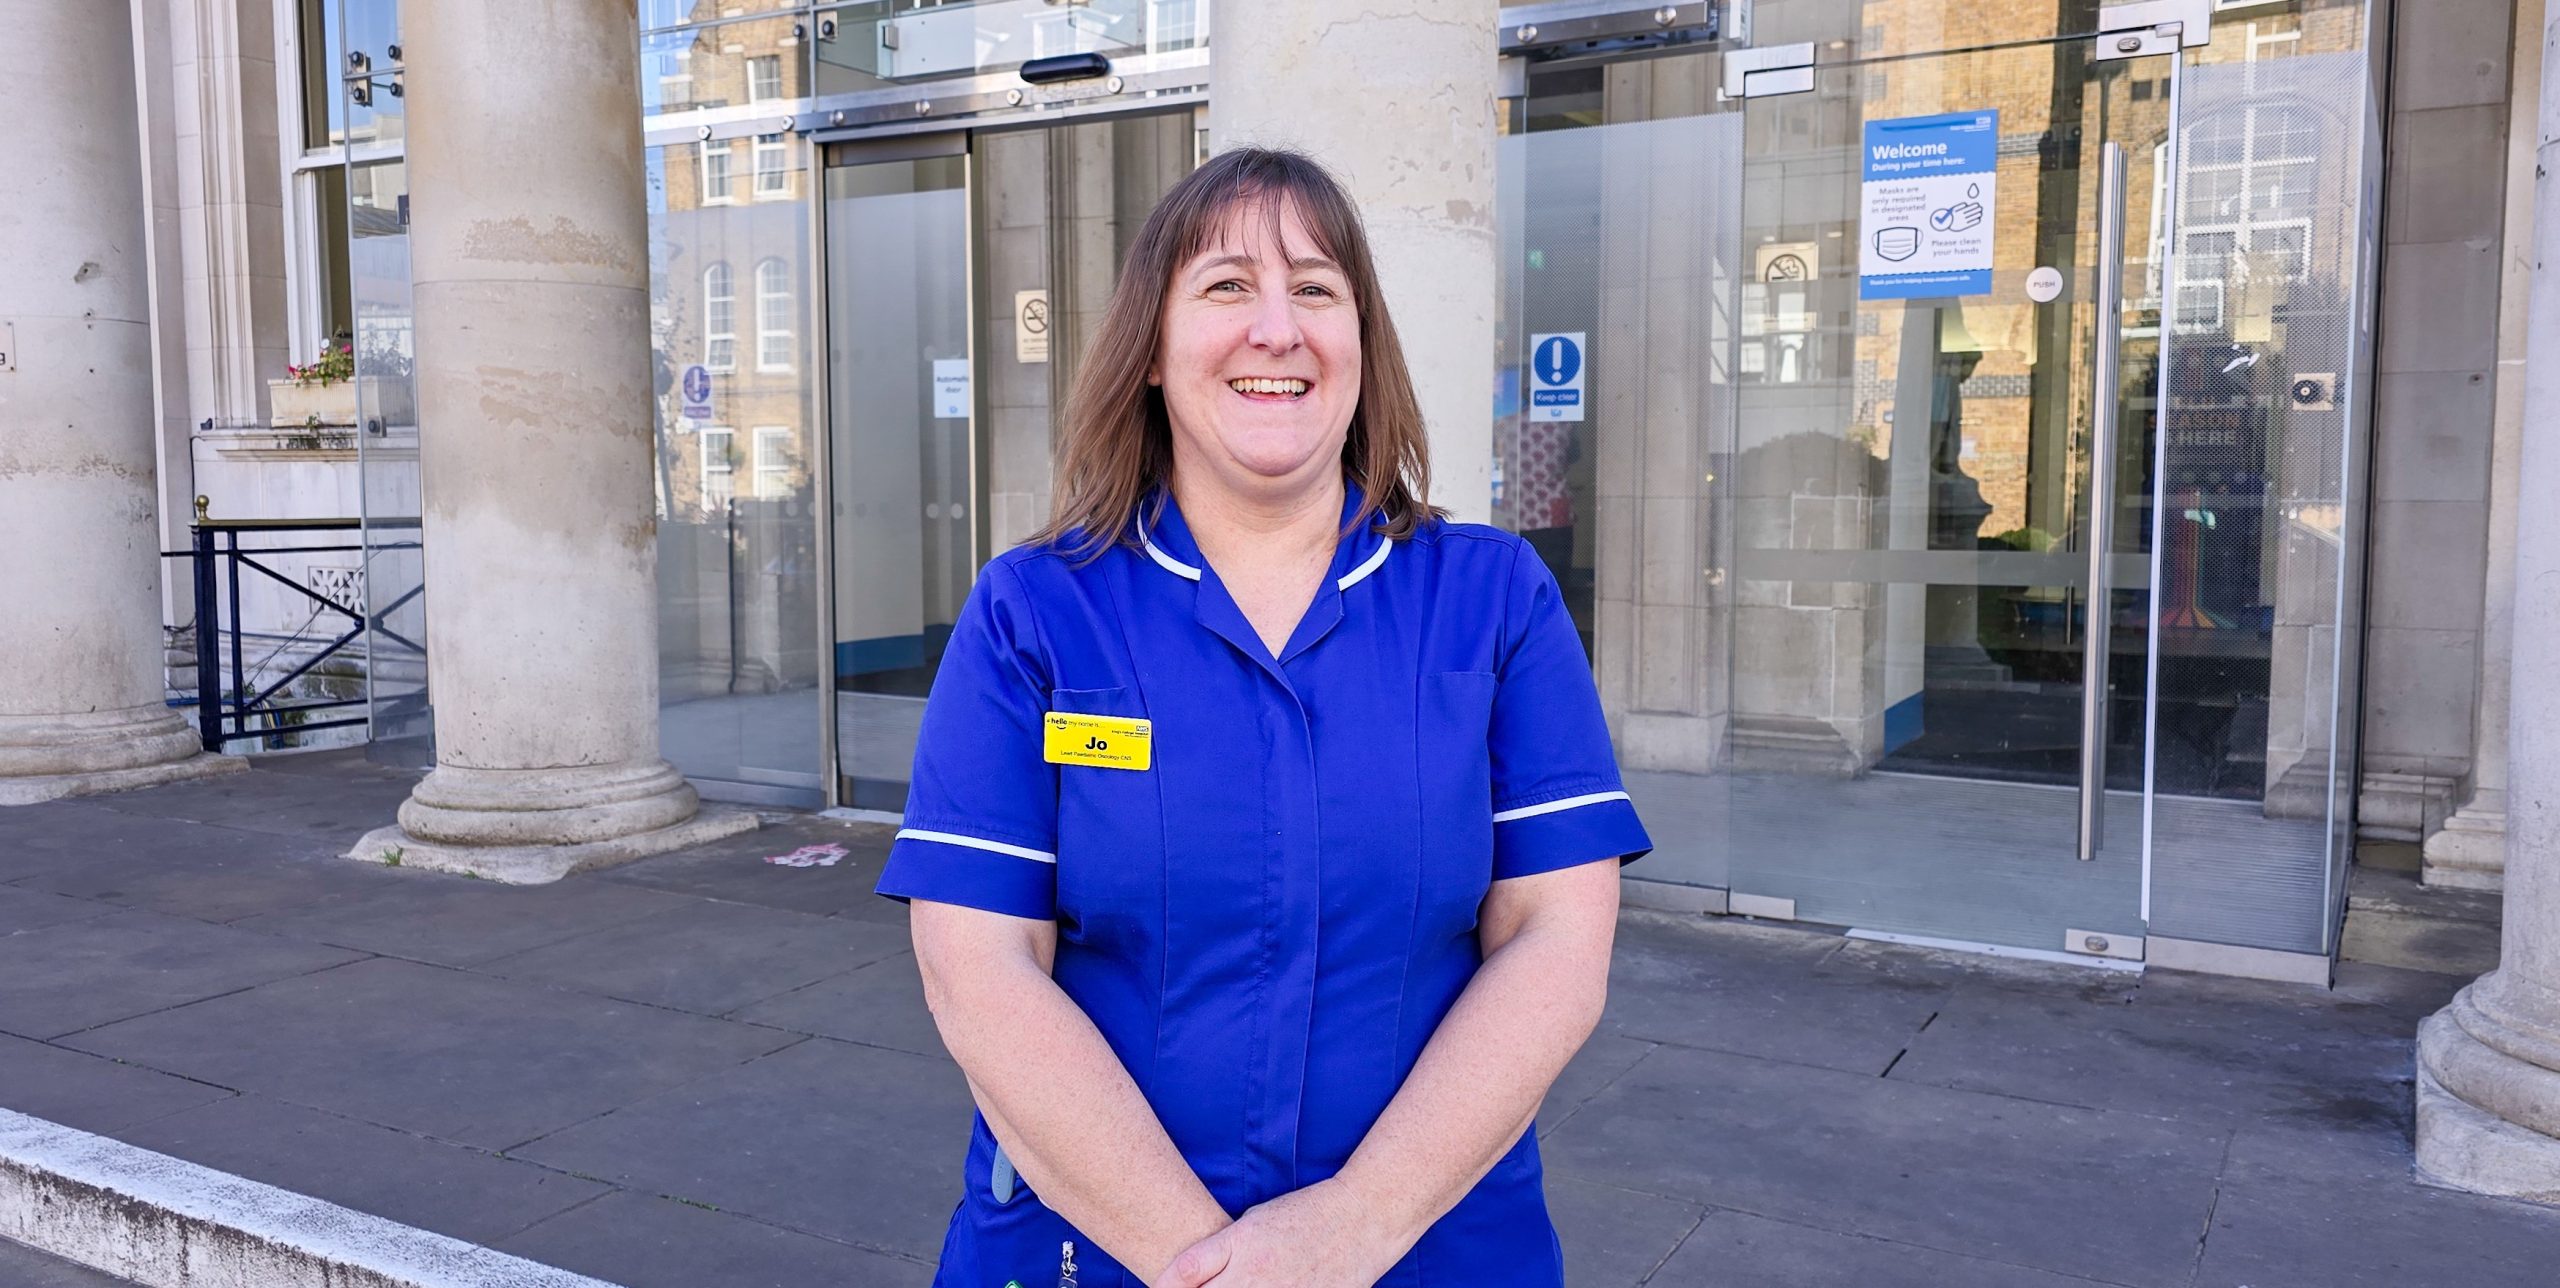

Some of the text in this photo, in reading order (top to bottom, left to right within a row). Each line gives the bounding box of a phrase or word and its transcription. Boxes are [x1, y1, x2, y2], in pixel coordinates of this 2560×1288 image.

[1872, 142, 1948, 161] Welcome
[1872, 157, 1966, 172] During your time here:
[1879, 187, 1904, 195] Masks
[1872, 194, 1926, 206] only required
[1881, 203, 1926, 214] designated
[1931, 237, 1982, 247] Please clean
[1932, 247, 1980, 258] your hands
[1535, 392, 1577, 403] Keep clear
[2178, 430, 2237, 446] HERE
[1051, 717, 1068, 725] hello
[1085, 736, 1108, 751] Jo
